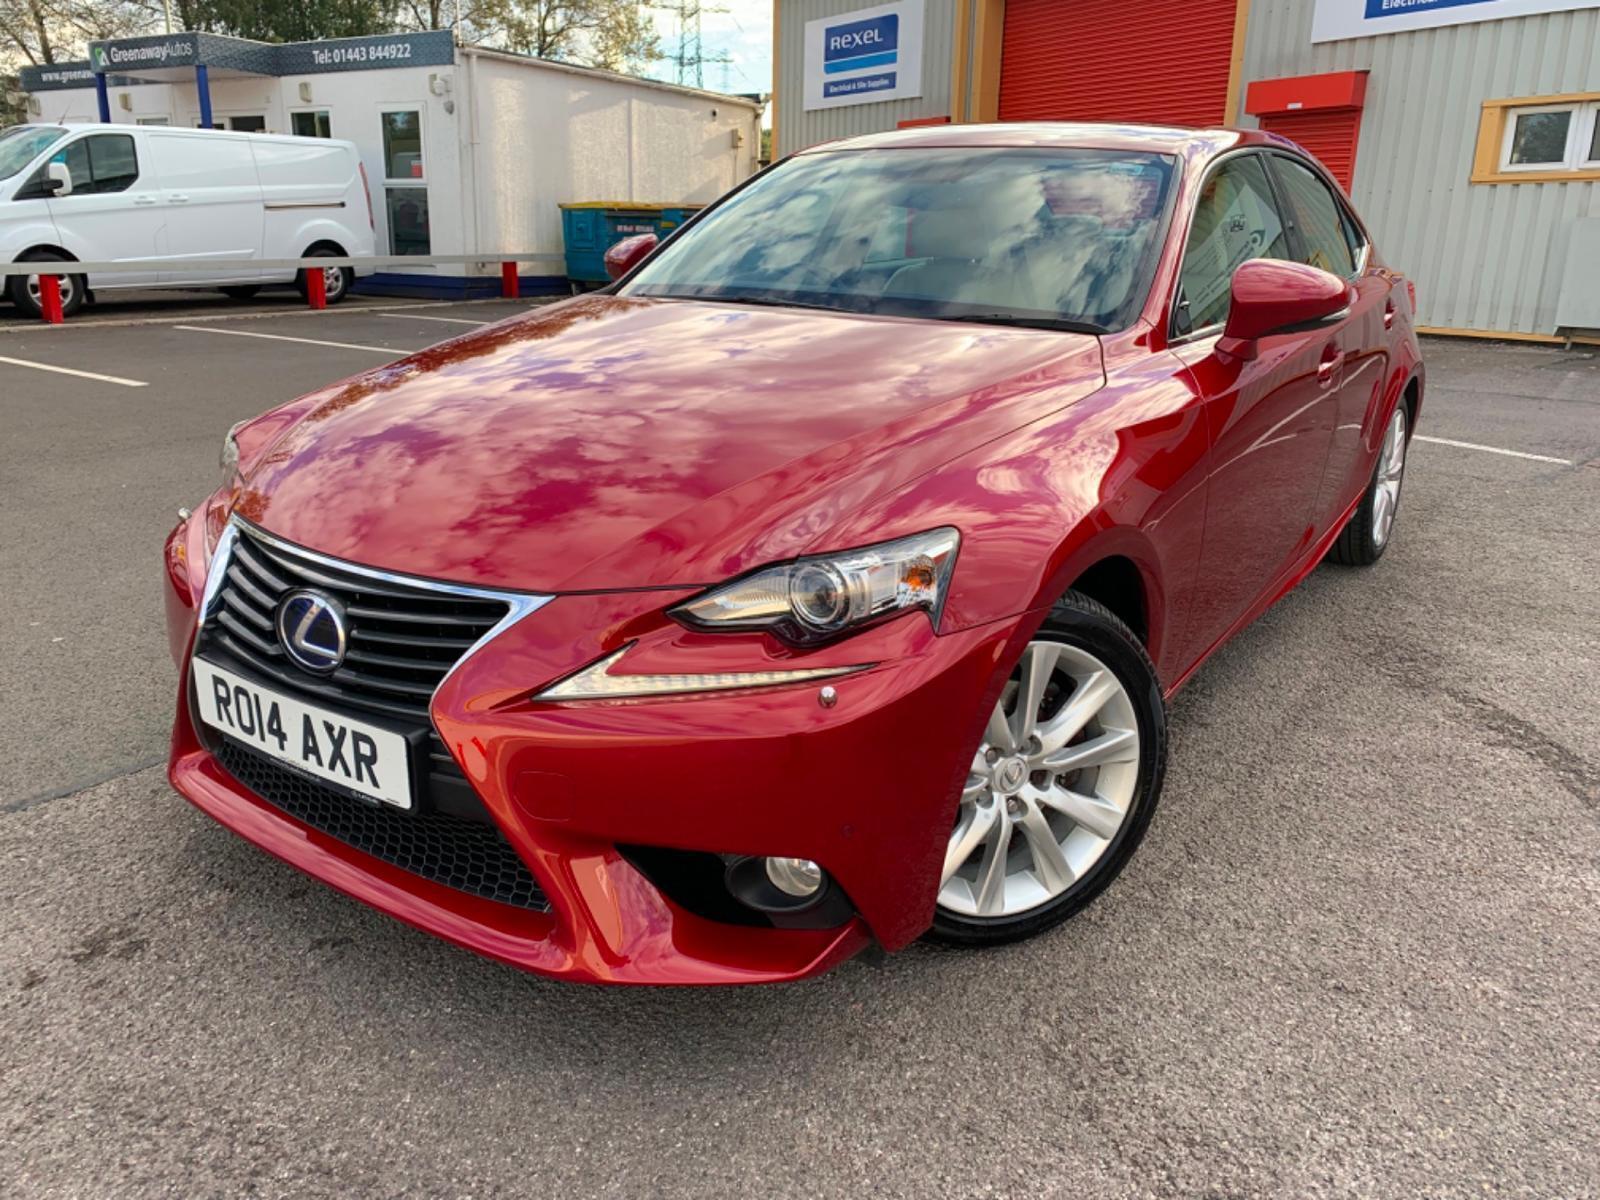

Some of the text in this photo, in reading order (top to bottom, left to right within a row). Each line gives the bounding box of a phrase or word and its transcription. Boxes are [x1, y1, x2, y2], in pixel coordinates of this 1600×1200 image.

[312, 43, 411, 64] Tel: 01443 844922
[211, 674, 381, 789] RO14 AXR
